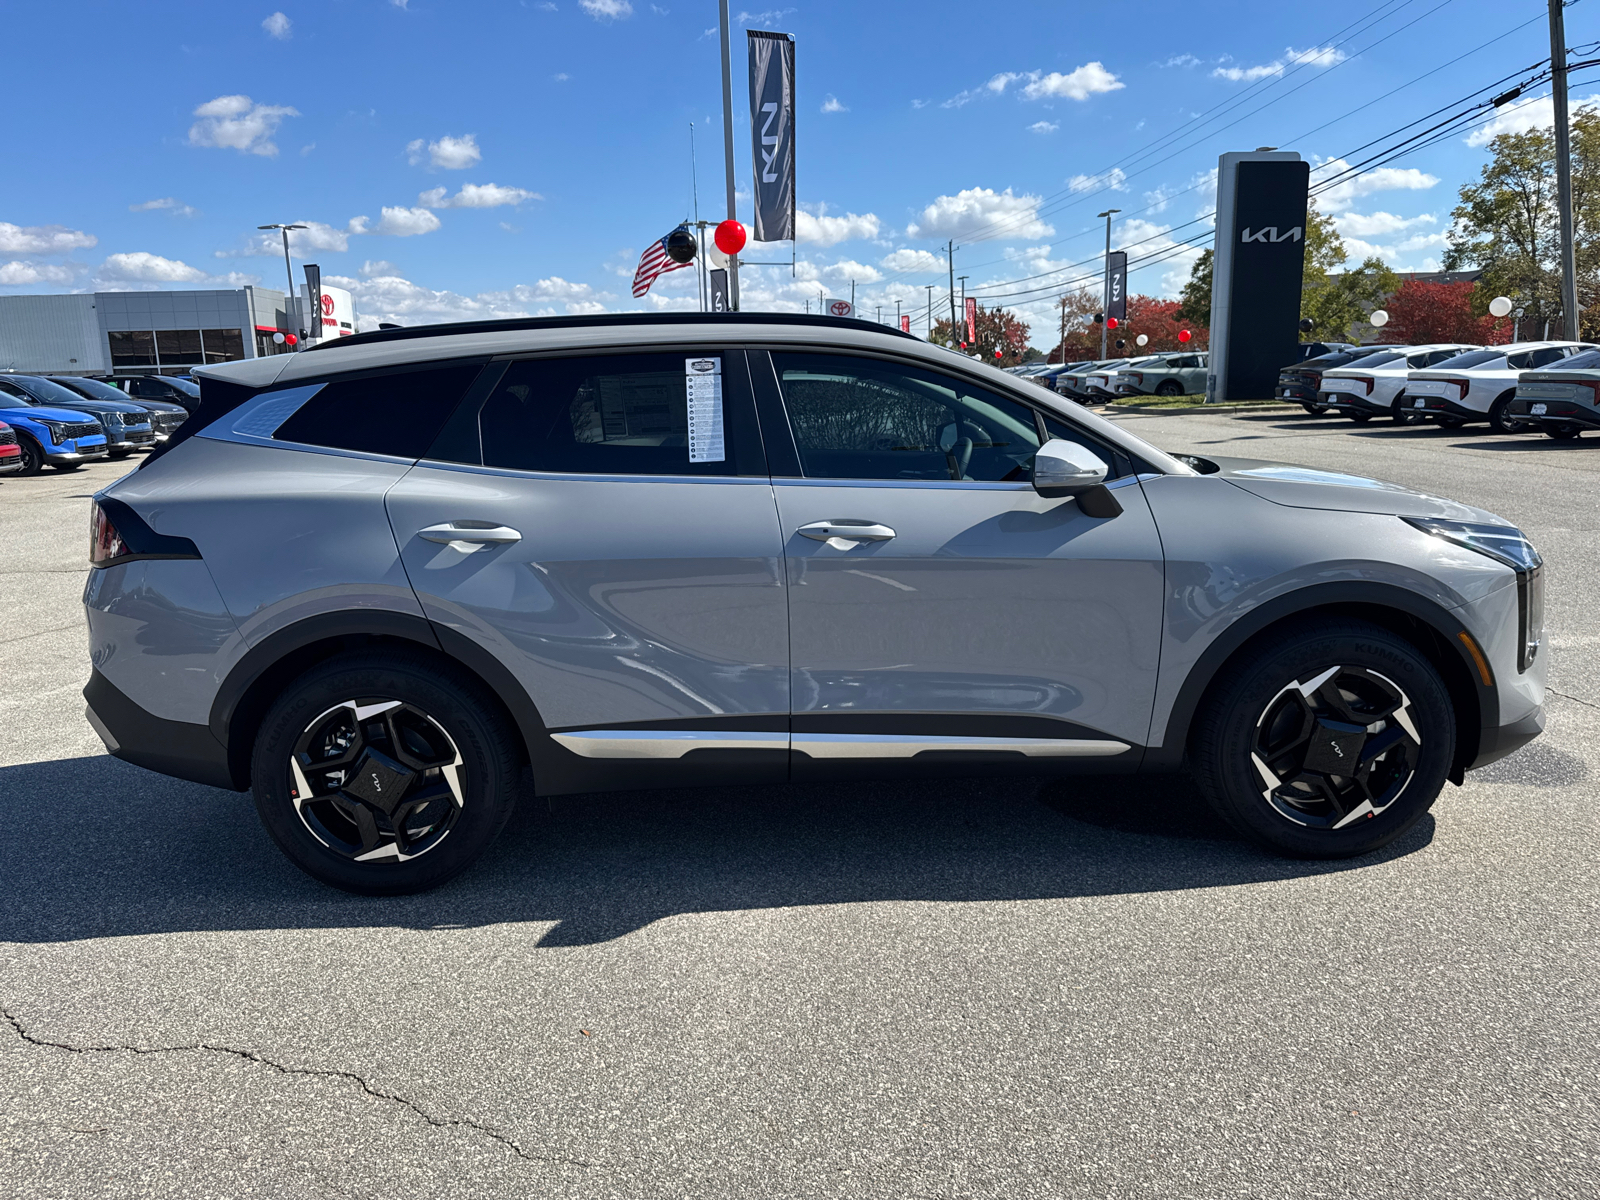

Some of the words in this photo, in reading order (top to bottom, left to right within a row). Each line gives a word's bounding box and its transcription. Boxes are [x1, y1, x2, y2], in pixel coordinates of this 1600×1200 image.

[761, 102, 779, 183] KIA
[1241, 226, 1302, 243] KIA
[1354, 642, 1415, 673] KUMHO
[266, 696, 307, 751] KUMHO
